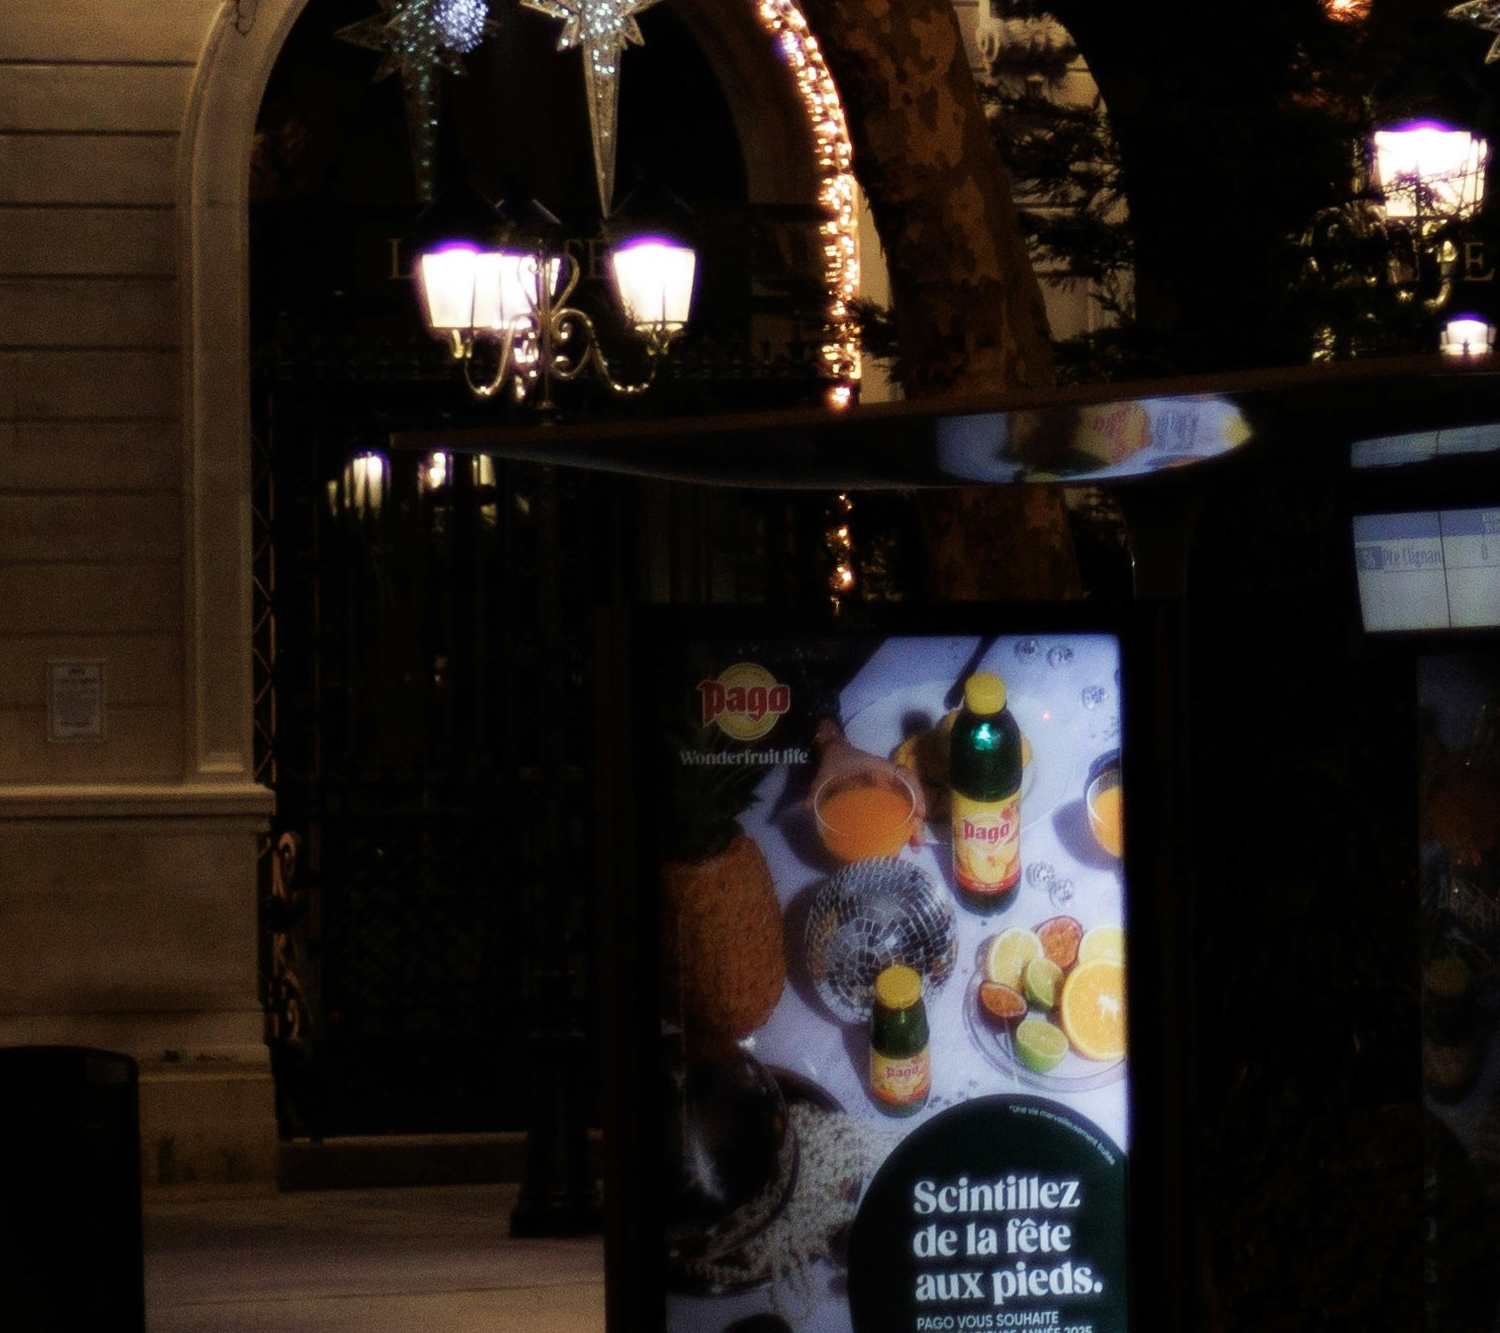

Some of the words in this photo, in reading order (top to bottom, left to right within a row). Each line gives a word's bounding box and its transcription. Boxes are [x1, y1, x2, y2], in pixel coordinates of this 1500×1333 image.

[679, 747, 783, 766] Wonderfruit
[913, 1175, 1081, 1214] Scintillez
[913, 1224, 958, 1258] de
[966, 1222, 998, 1255] la
[1006, 1217, 1072, 1254] fête
[915, 1272, 986, 1301] aux
[991, 1260, 1104, 1306] pieds.
[916, 1316, 954, 1331] PAGO
[956, 1314, 993, 1328] VOUS
[996, 1311, 1060, 1326] SOUHAITE
